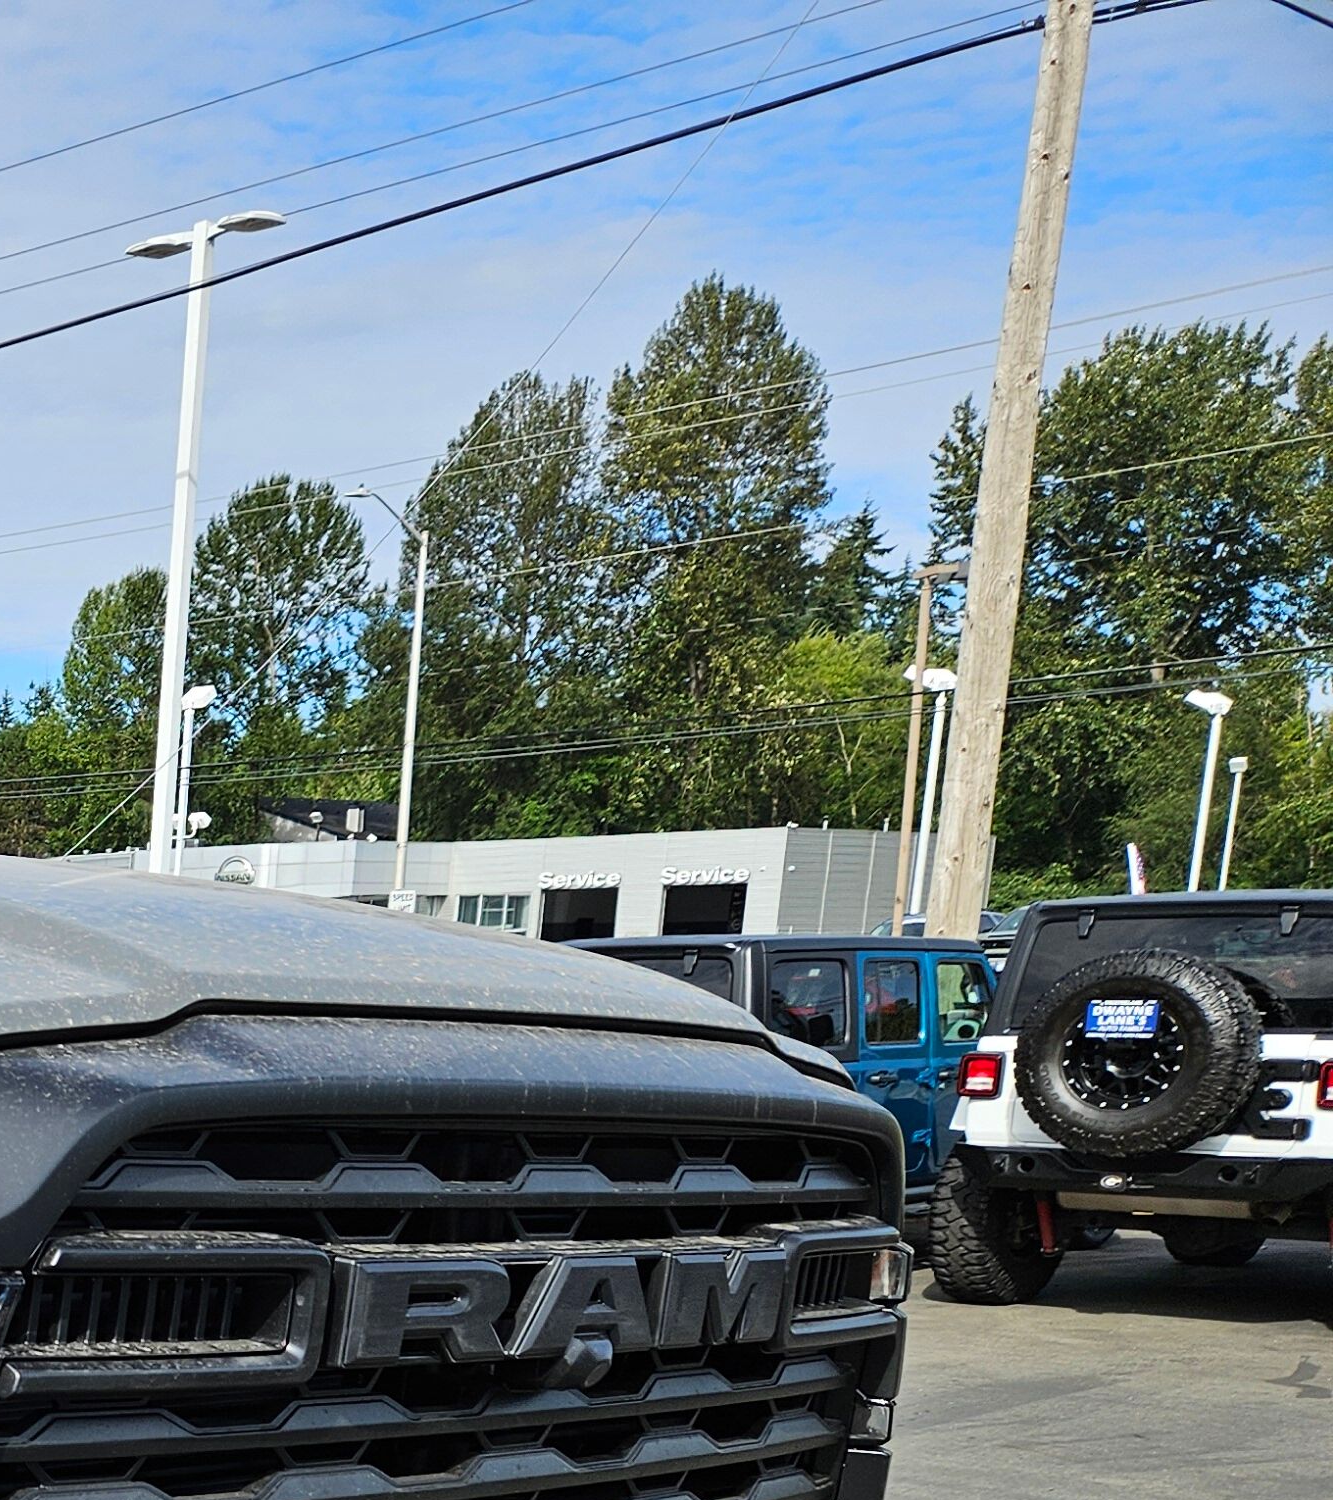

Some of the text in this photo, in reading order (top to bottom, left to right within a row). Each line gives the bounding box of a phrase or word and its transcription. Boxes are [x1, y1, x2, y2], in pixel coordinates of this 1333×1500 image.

[538, 870, 622, 889] Service
[660, 865, 751, 885] Service
[1092, 1005, 1155, 1016] DWAYNE
[335, 1248, 786, 1368] RAM
